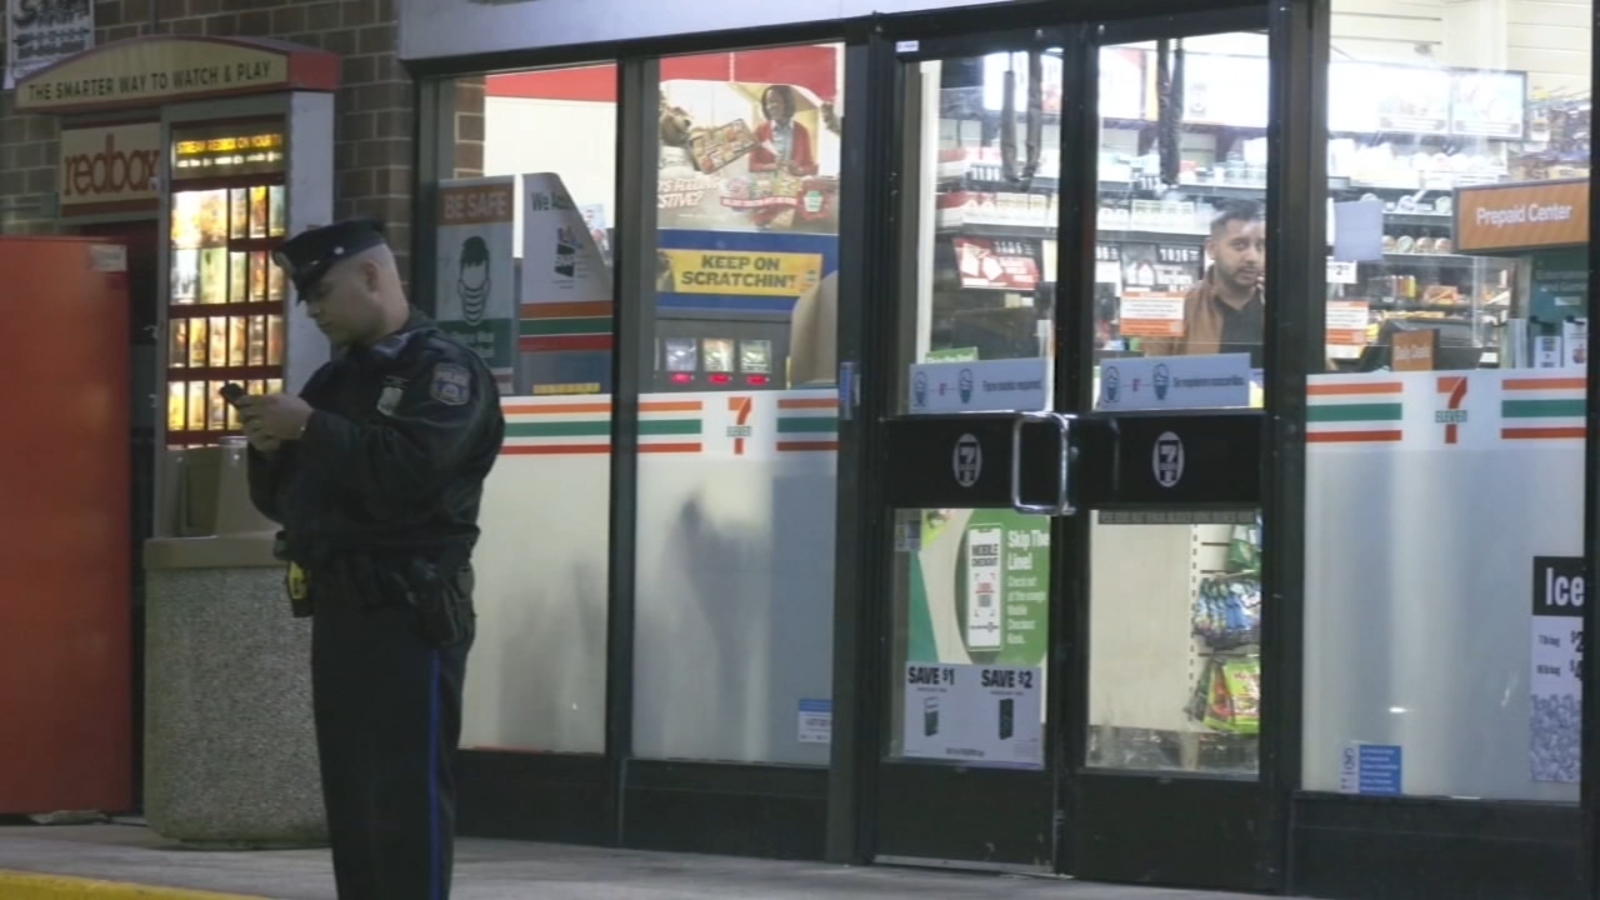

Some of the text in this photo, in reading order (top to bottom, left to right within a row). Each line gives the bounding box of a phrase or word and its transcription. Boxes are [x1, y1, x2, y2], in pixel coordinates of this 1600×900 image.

[29, 84, 51, 100] THE
[56, 78, 115, 97] SMARTER
[119, 74, 147, 92] WAY
[150, 73, 168, 90] TO
[173, 67, 218, 88] WATCH
[238, 60, 271, 80] PLAY
[64, 133, 160, 195] redbox
[443, 191, 507, 219] BE SAFE
[531, 192, 549, 211] We
[1475, 203, 1573, 227] Prepaid Center
[701, 254, 780, 271] KEEP ON
[1436, 376, 1467, 444] 7
[728, 396, 752, 455] 7
[1007, 531, 1030, 550] Skip
[1007, 552, 1032, 570] Line!
[1546, 567, 1585, 607] Ice
[908, 667, 954, 685] SAVE $1
[981, 669, 1033, 688] SAVE $2
